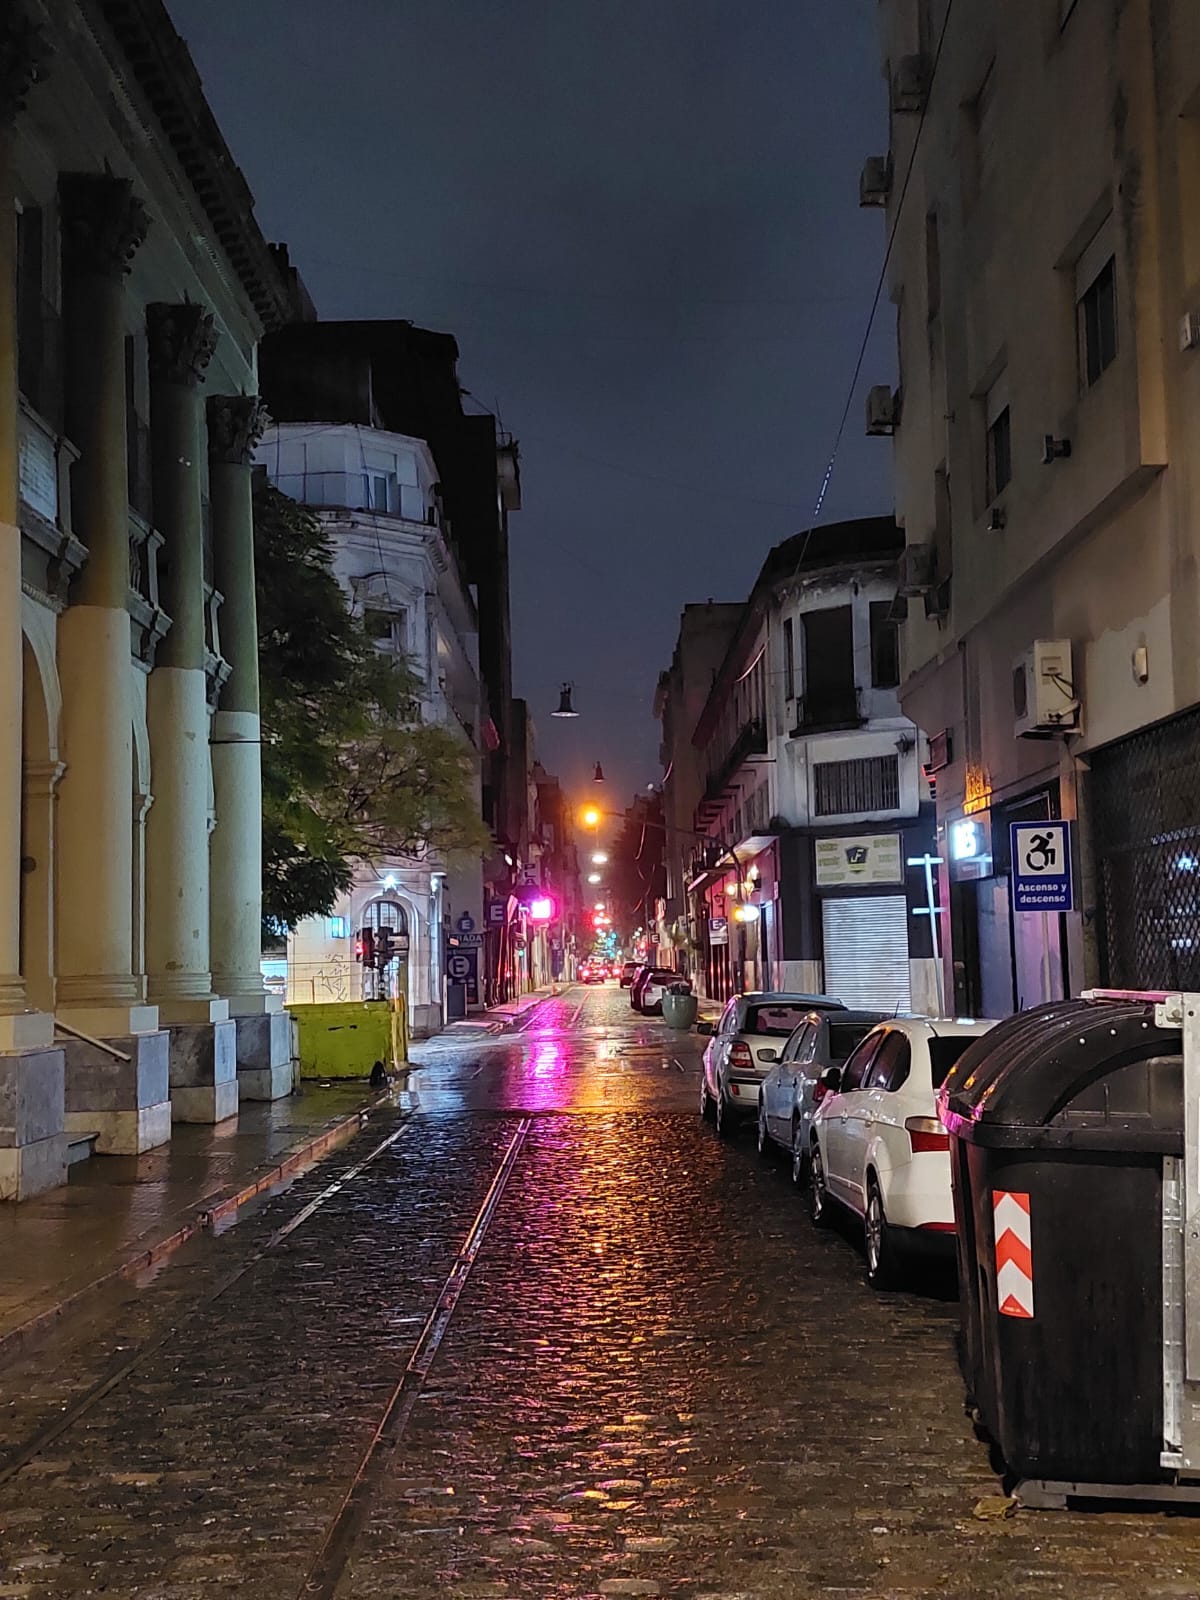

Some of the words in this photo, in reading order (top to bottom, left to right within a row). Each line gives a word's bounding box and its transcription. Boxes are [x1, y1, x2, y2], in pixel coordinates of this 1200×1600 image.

[1018, 883, 1059, 892] Ascenso
[1061, 883, 1067, 893] y
[1020, 894, 1066, 904] descenso
[490, 904, 504, 920] E
[461, 920, 471, 930] E
[453, 957, 466, 974] E
